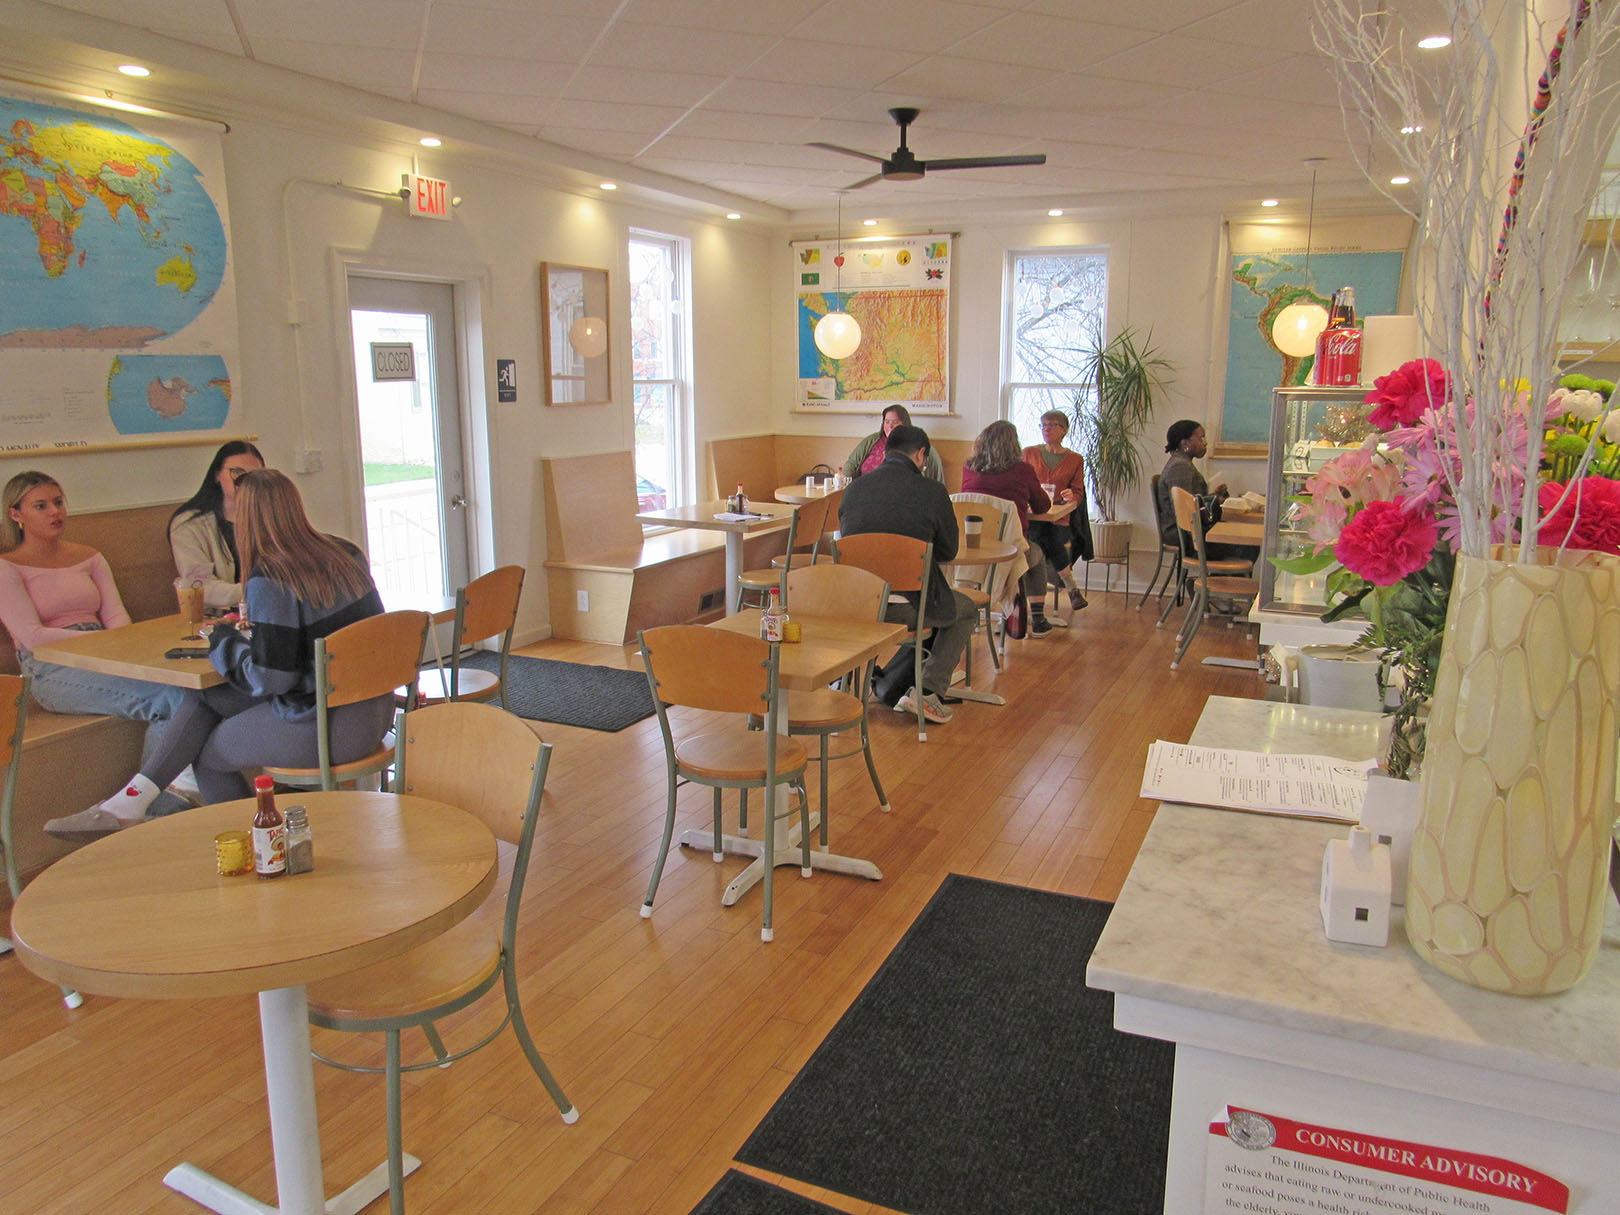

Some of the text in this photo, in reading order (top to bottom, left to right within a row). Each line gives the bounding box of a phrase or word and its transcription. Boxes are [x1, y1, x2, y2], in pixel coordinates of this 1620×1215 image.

[416, 177, 447, 216] EXIT
[376, 351, 410, 372] CLOSED
[1295, 1128, 1416, 1167] CONSUMER
[1420, 1155, 1538, 1194] ADVISORY
[1221, 1182, 1233, 1190] or
[1235, 1184, 1274, 1198] seafood
[1277, 1192, 1306, 1205] poses
[1317, 1199, 1350, 1215] health
[1224, 1164, 1262, 1178] advises
[1264, 1171, 1284, 1183] that
[1286, 1177, 1318, 1193] eating
[1321, 1186, 1339, 1196] raw
[1343, 1191, 1356, 1200] or
[1358, 1195, 1428, 1215] undercooked
[1225, 1198, 1241, 1208] the
[1271, 1155, 1490, 1213] The Illinois Departent of Public Health
